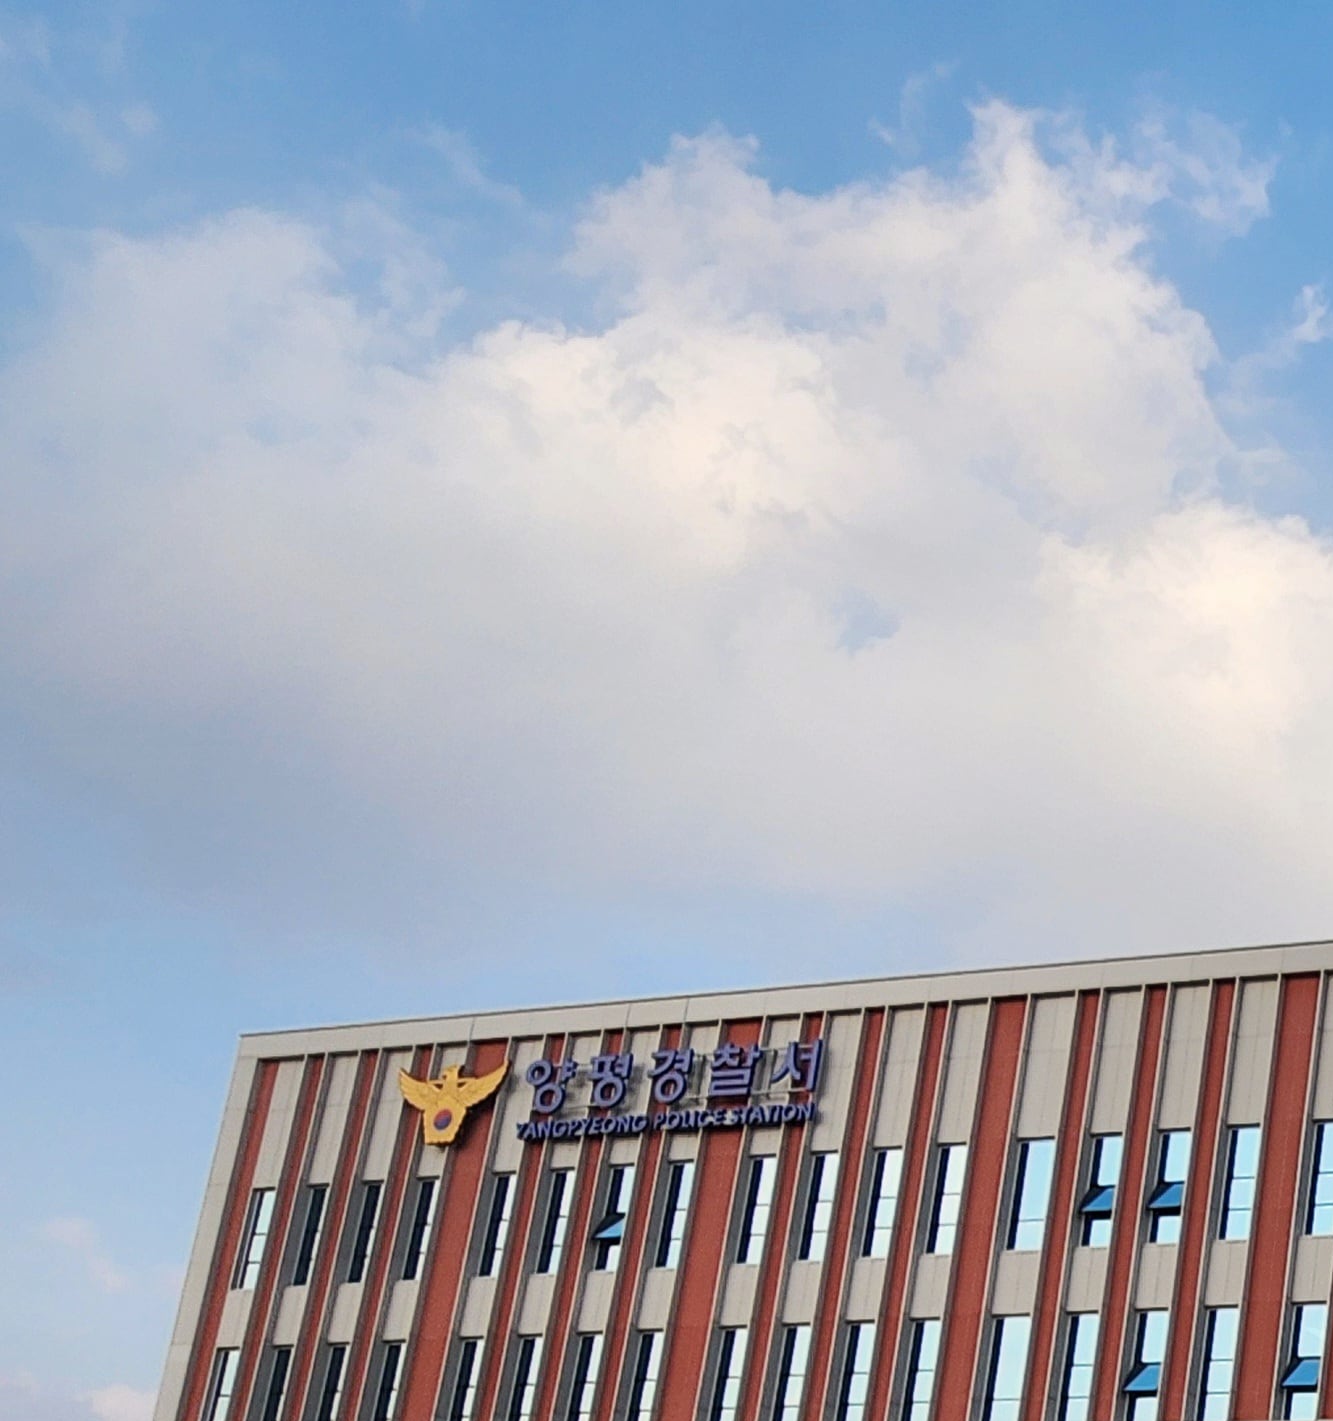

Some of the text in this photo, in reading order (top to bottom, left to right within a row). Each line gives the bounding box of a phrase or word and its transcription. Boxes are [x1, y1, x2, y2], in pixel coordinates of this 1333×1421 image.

[525, 1038, 823, 1115] 양평경찰서
[516, 1101, 816, 1141] YANGPYEONG POLICE STATION
